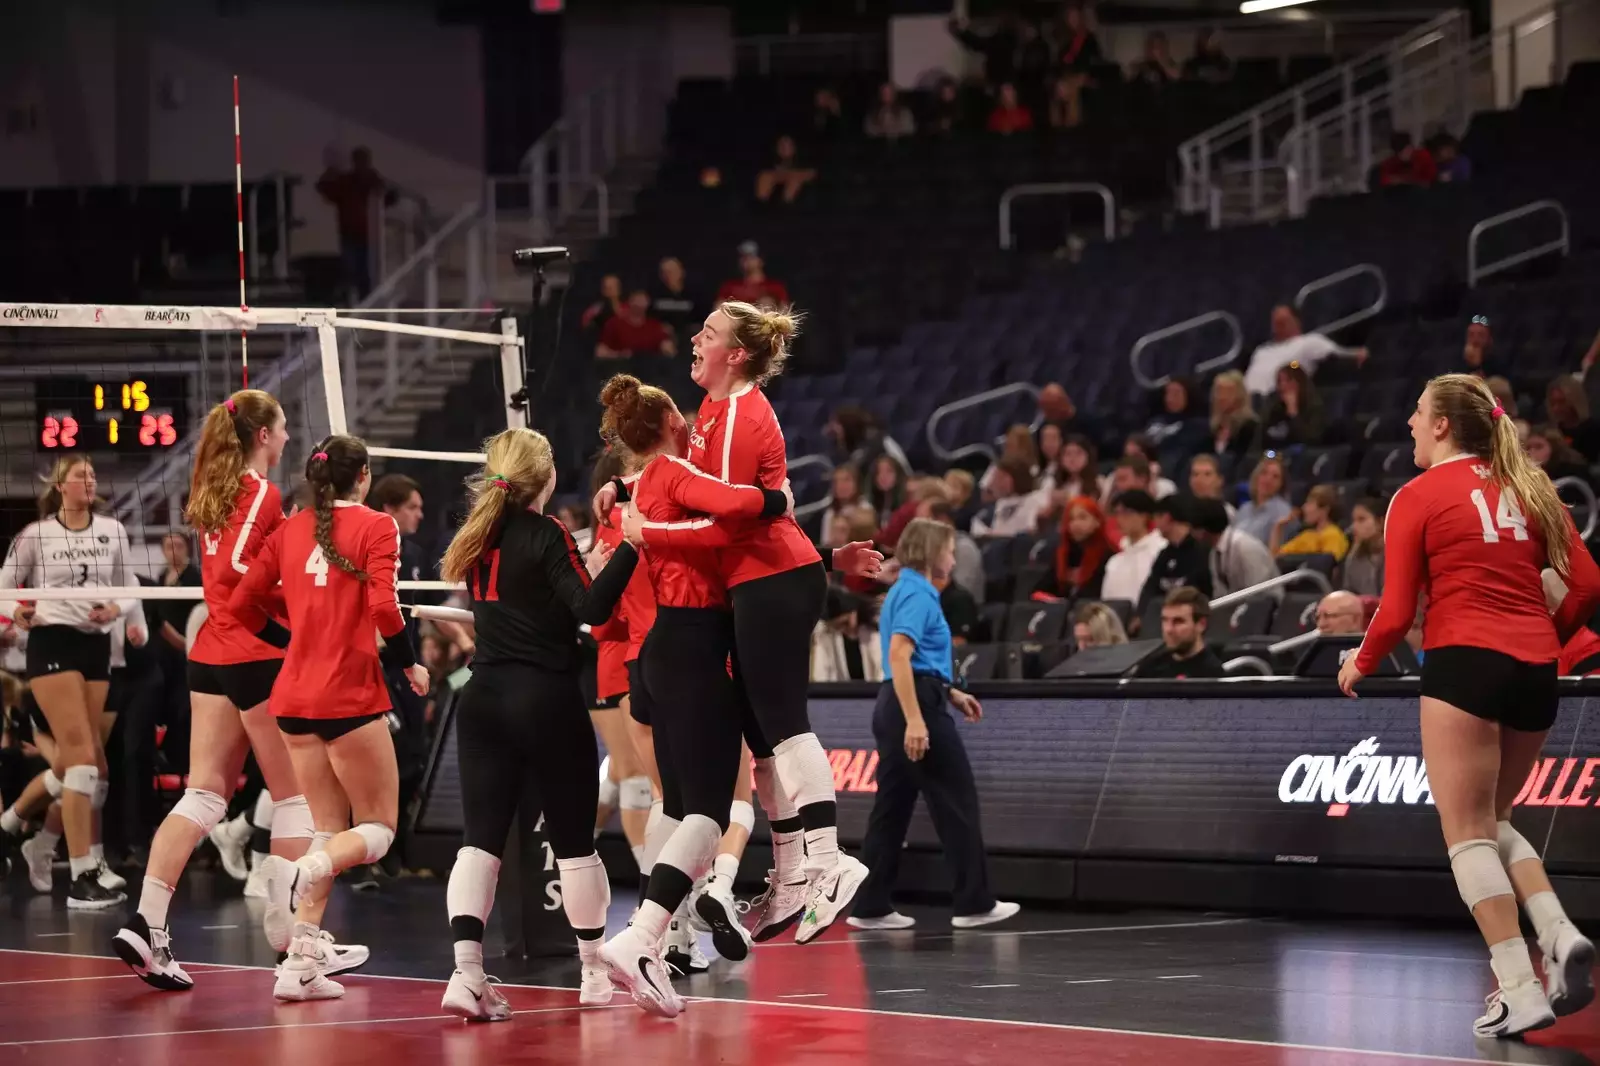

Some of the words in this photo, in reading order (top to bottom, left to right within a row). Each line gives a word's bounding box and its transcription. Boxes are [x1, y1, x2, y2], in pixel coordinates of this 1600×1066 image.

[3, 306, 58, 321] CINCINNATI
[144, 309, 191, 323] BEARCATS
[121, 380, 150, 412] 15
[42, 416, 79, 448] 22
[109, 417, 118, 444] 1
[139, 414, 177, 446] 25
[1470, 486, 1529, 543] 14
[52, 546, 109, 561] CINCINNATI
[305, 544, 329, 587] 4
[77, 563, 88, 586] 3
